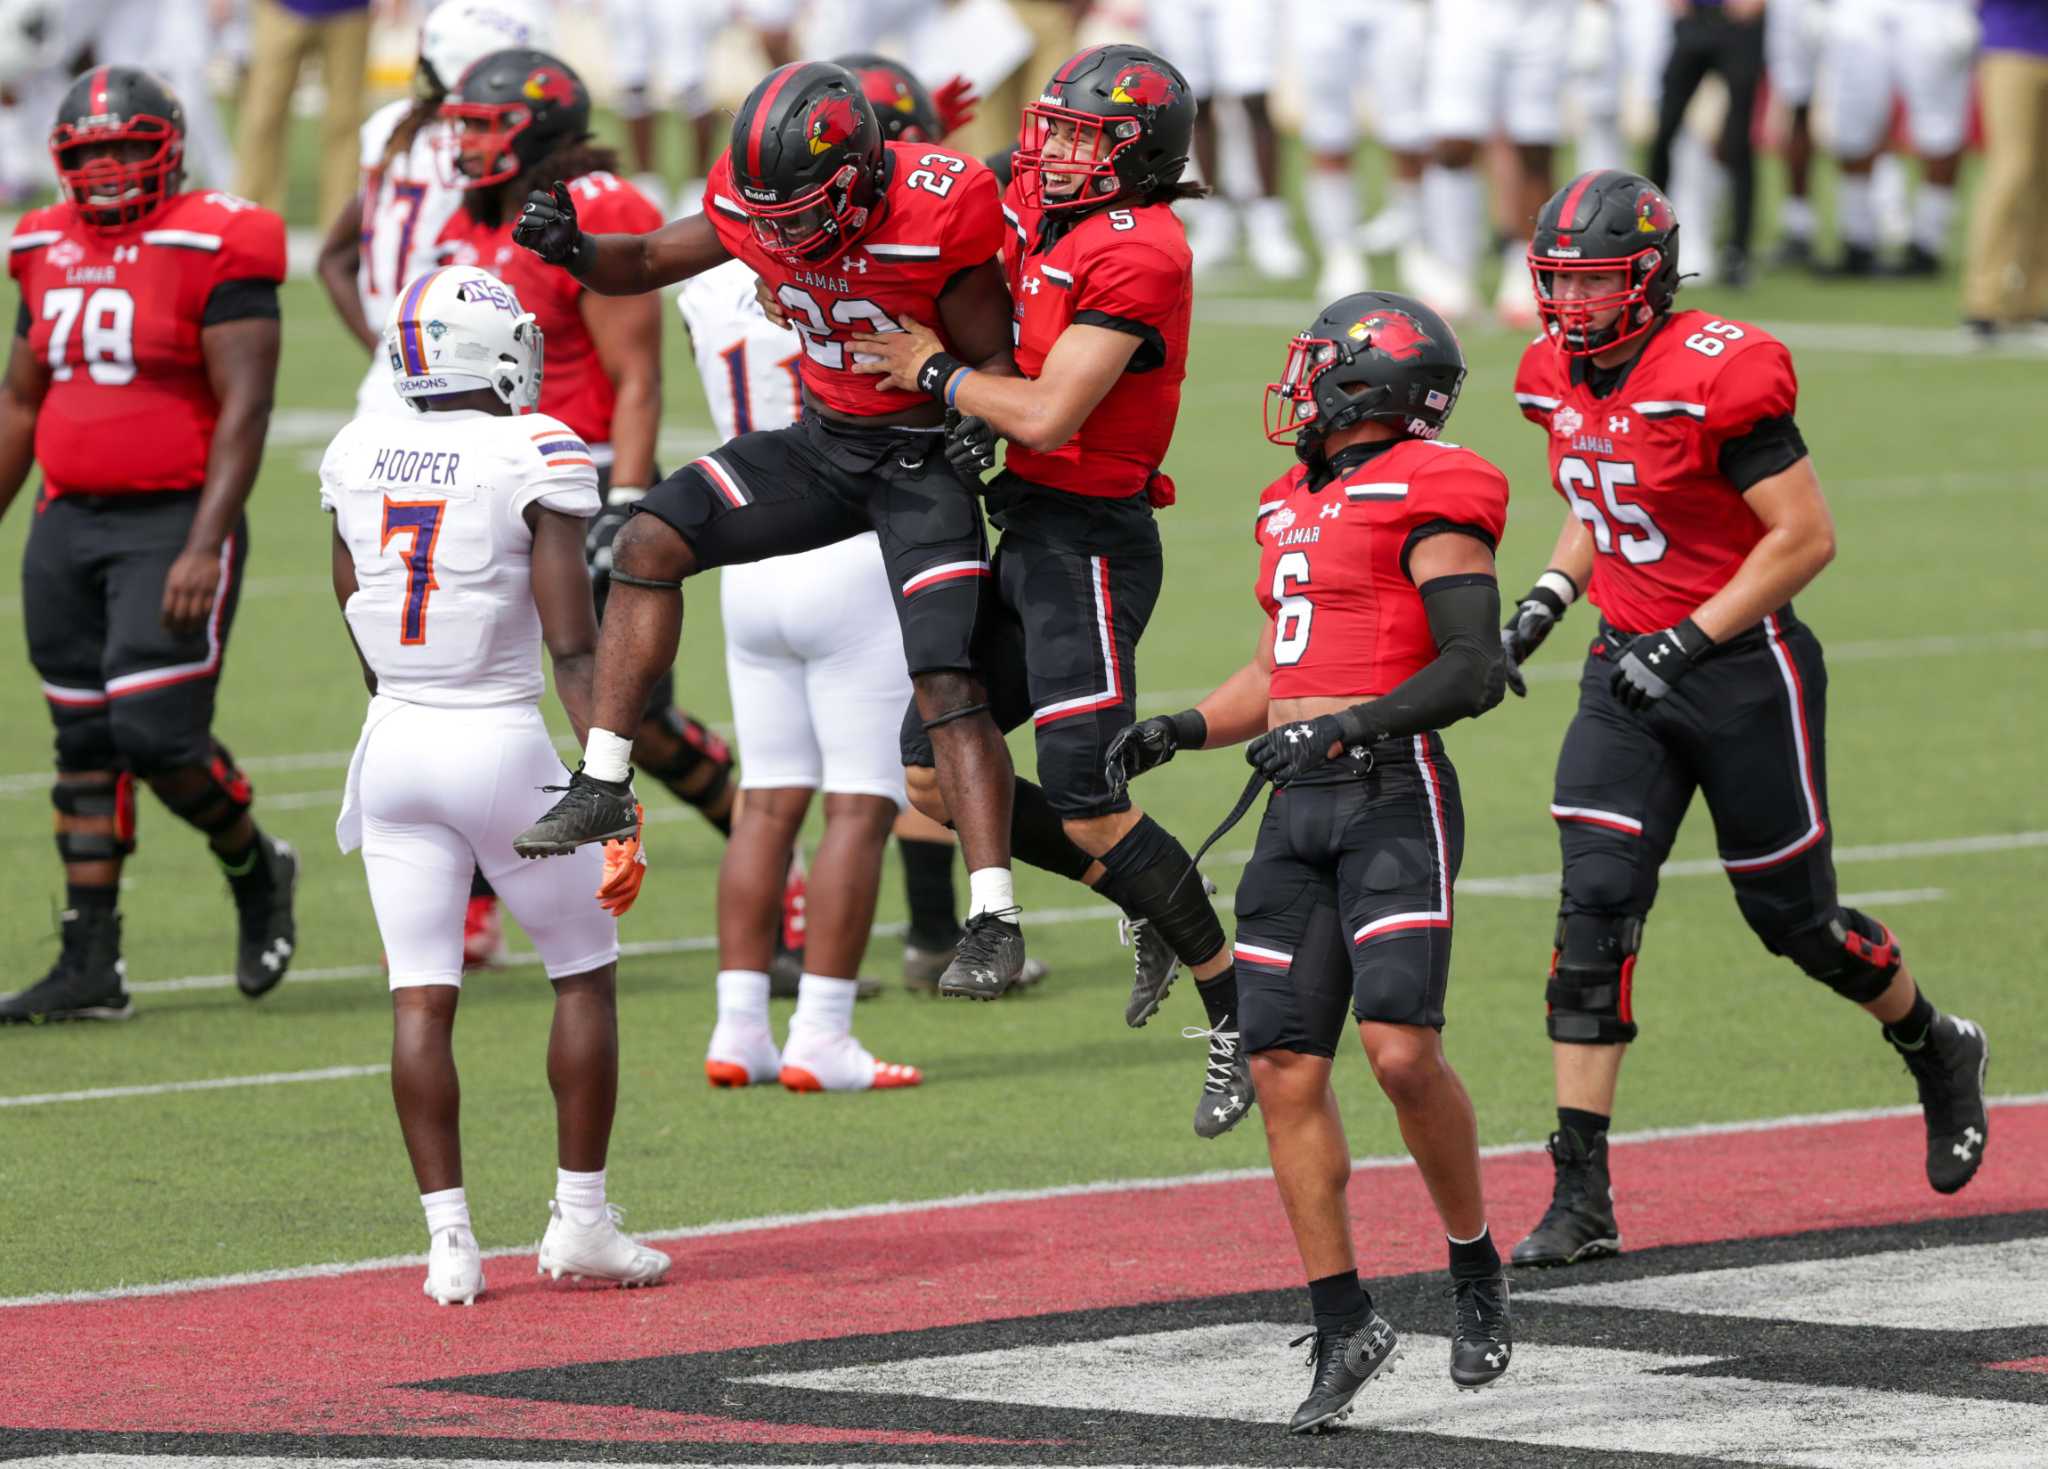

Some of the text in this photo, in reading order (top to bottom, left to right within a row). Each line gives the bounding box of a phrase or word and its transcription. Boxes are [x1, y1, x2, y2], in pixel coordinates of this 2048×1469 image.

[907, 153, 968, 198] 23
[1108, 208, 1136, 231] 5
[67, 266, 117, 283] LAMAR
[795, 271, 850, 292] LAMAR
[43, 287, 137, 385] 78
[1683, 319, 1745, 358] 65
[432, 349, 442, 361] 7
[400, 377, 448, 392] DEMONS
[1571, 434, 1614, 454] LAMAR
[369, 448, 460, 486] HOOPER
[1558, 455, 1669, 565] 65
[1278, 526, 1320, 547] LAMAR
[380, 492, 448, 646] 7
[1272, 550, 1315, 667] 6
